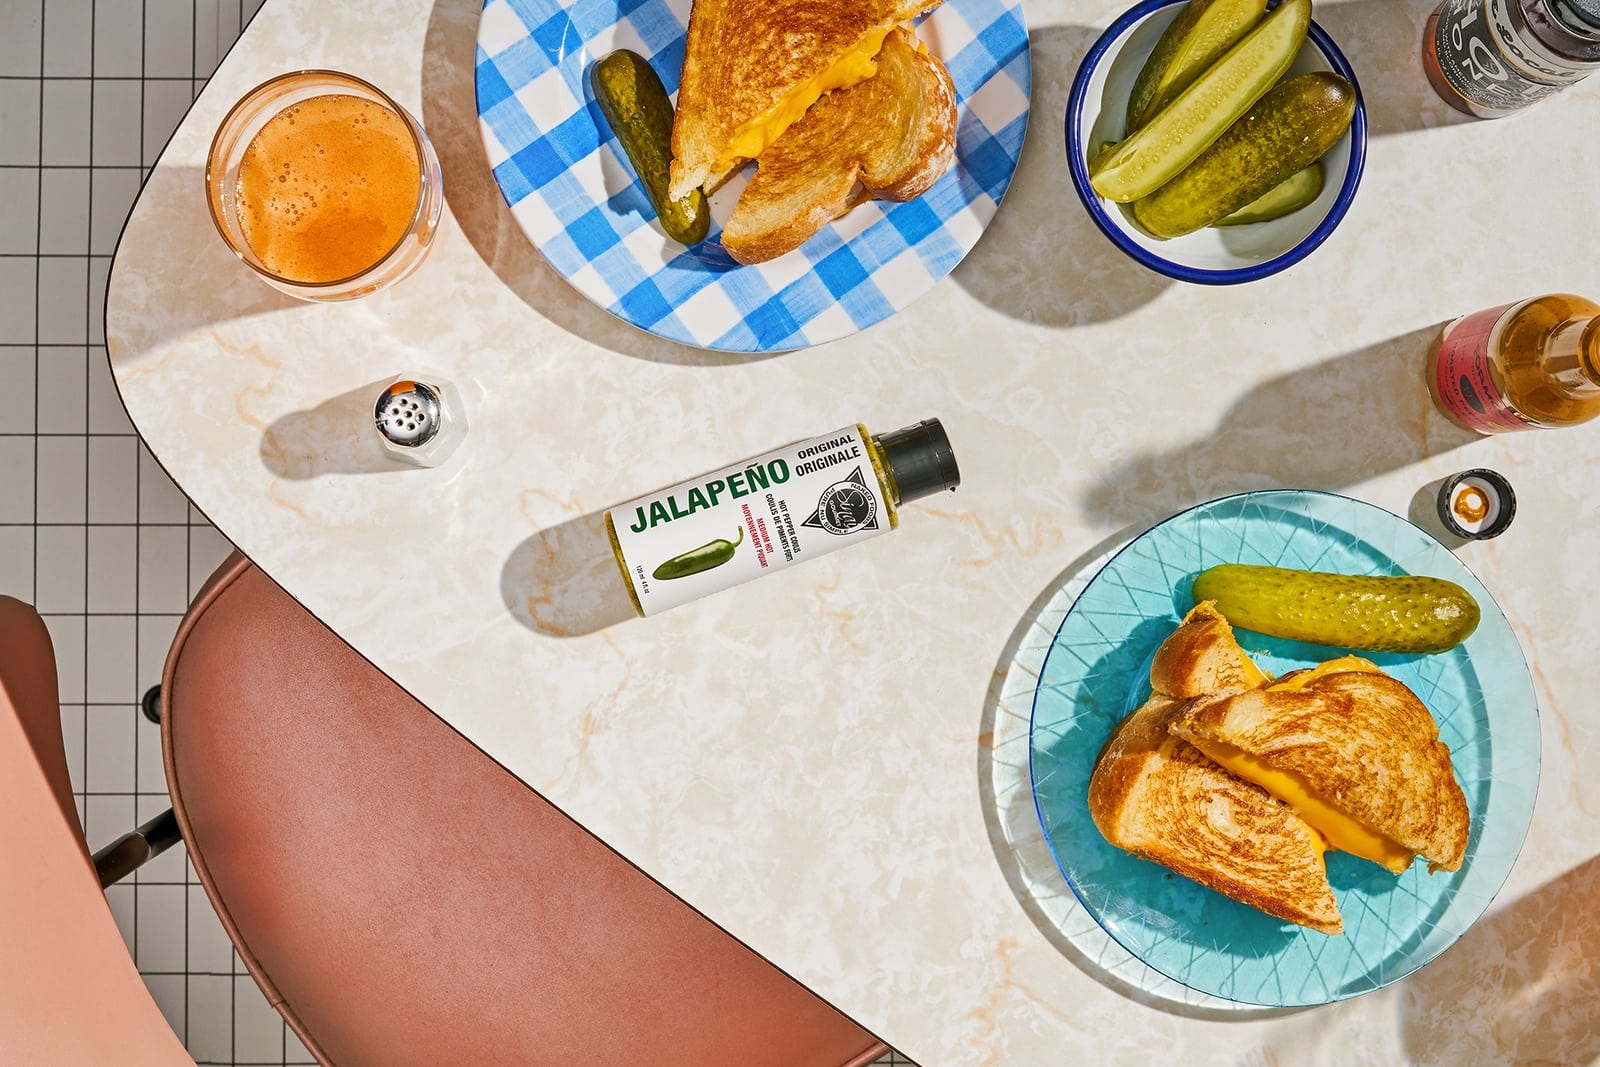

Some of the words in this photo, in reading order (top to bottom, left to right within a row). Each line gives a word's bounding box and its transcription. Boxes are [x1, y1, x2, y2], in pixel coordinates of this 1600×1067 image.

[797, 434, 856, 460] ORIGINAL
[795, 446, 861, 477] ORIGINALE
[630, 458, 790, 533] JALAPEÑO
[766, 493, 778, 516] COULIS
[820, 487, 836, 507] PURE
[850, 483, 873, 502] NAKED
[778, 500, 788, 512] HOT
[741, 504, 762, 548] MOYENNEMENT
[773, 516, 782, 525] DE
[782, 512, 796, 536] PEPPER
[823, 521, 849, 534] SIMPLE
[756, 517, 770, 543] MEDIUM
[764, 542, 774, 554] HOT
[776, 525, 790, 550] PIMENTS
